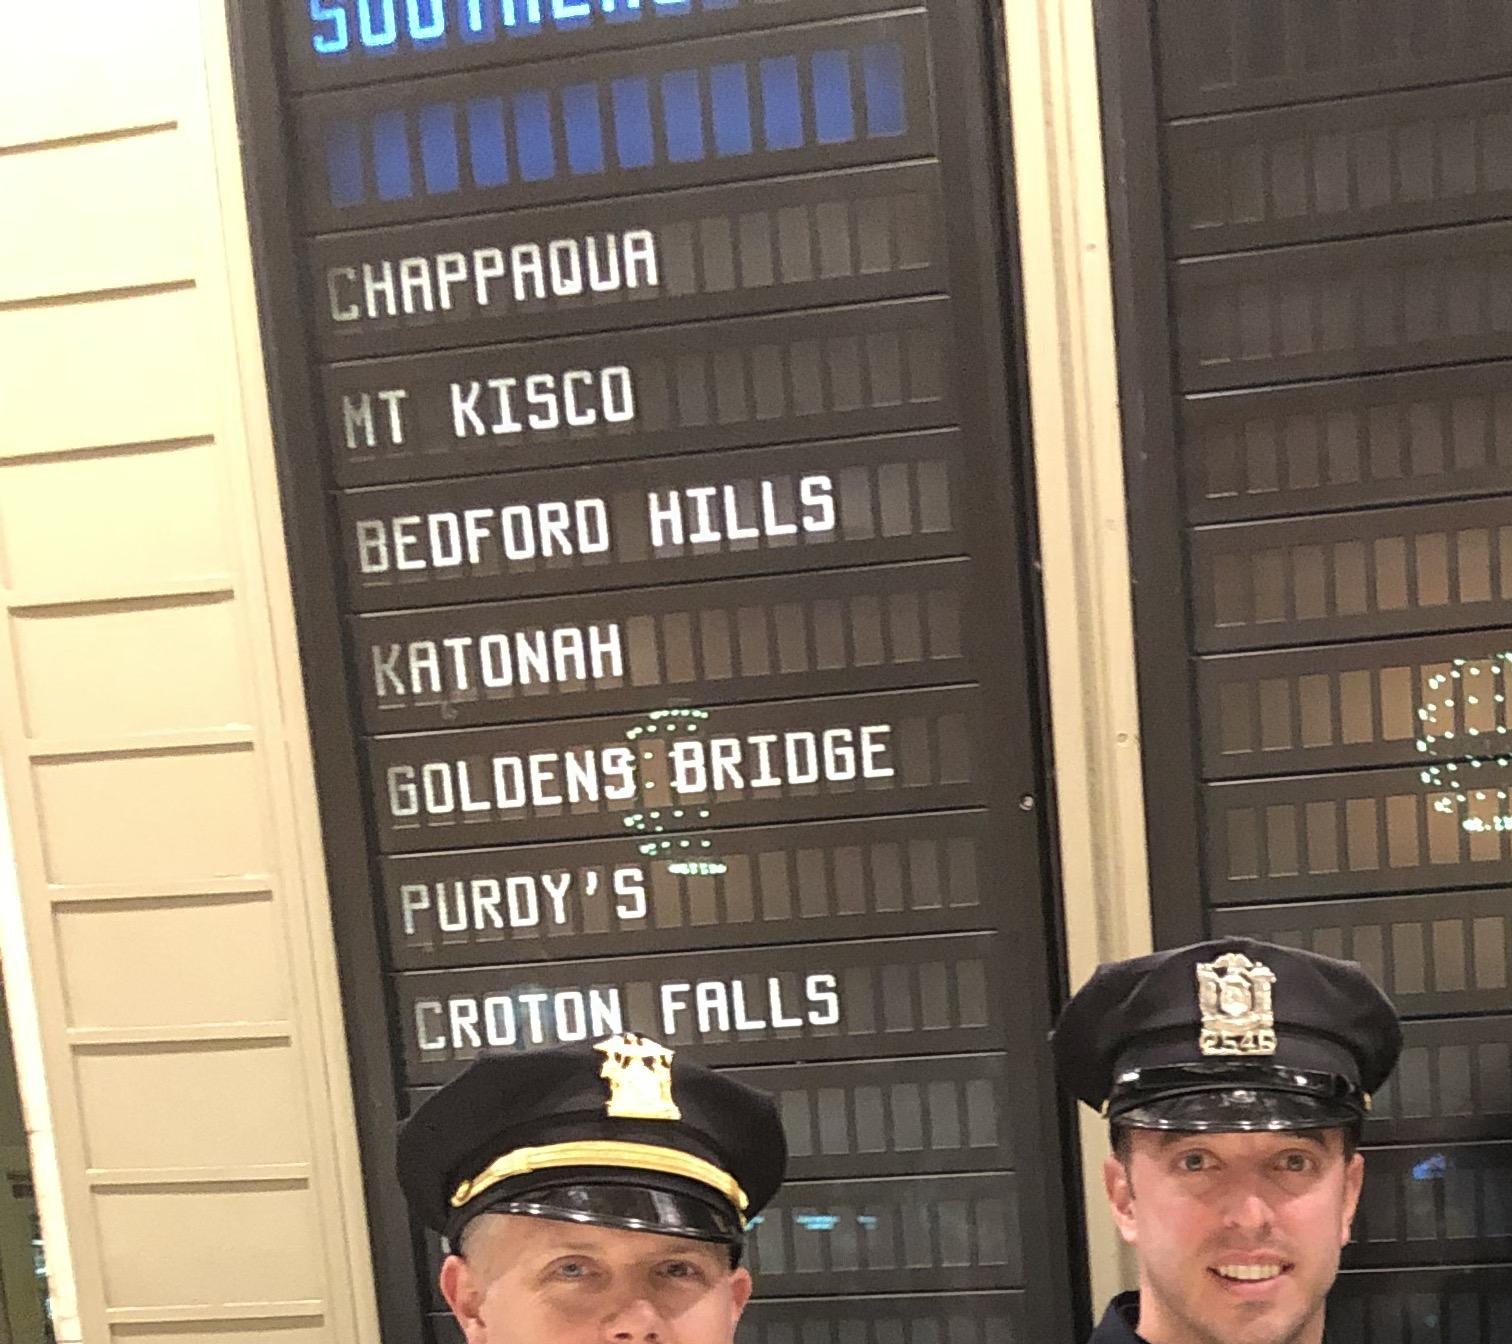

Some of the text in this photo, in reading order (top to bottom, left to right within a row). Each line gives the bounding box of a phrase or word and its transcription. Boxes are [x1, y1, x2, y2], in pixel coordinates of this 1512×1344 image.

[327, 229, 659, 322] CHAPPAQUA
[342, 365, 635, 449] MT KISCO
[356, 475, 836, 574] BEDFORD HILLS
[372, 623, 624, 697] KATONAH
[386, 725, 894, 817] GOLDENS BRIDGE
[400, 867, 647, 935] PURDY'S
[415, 974, 840, 1051] CROTON FALLS
